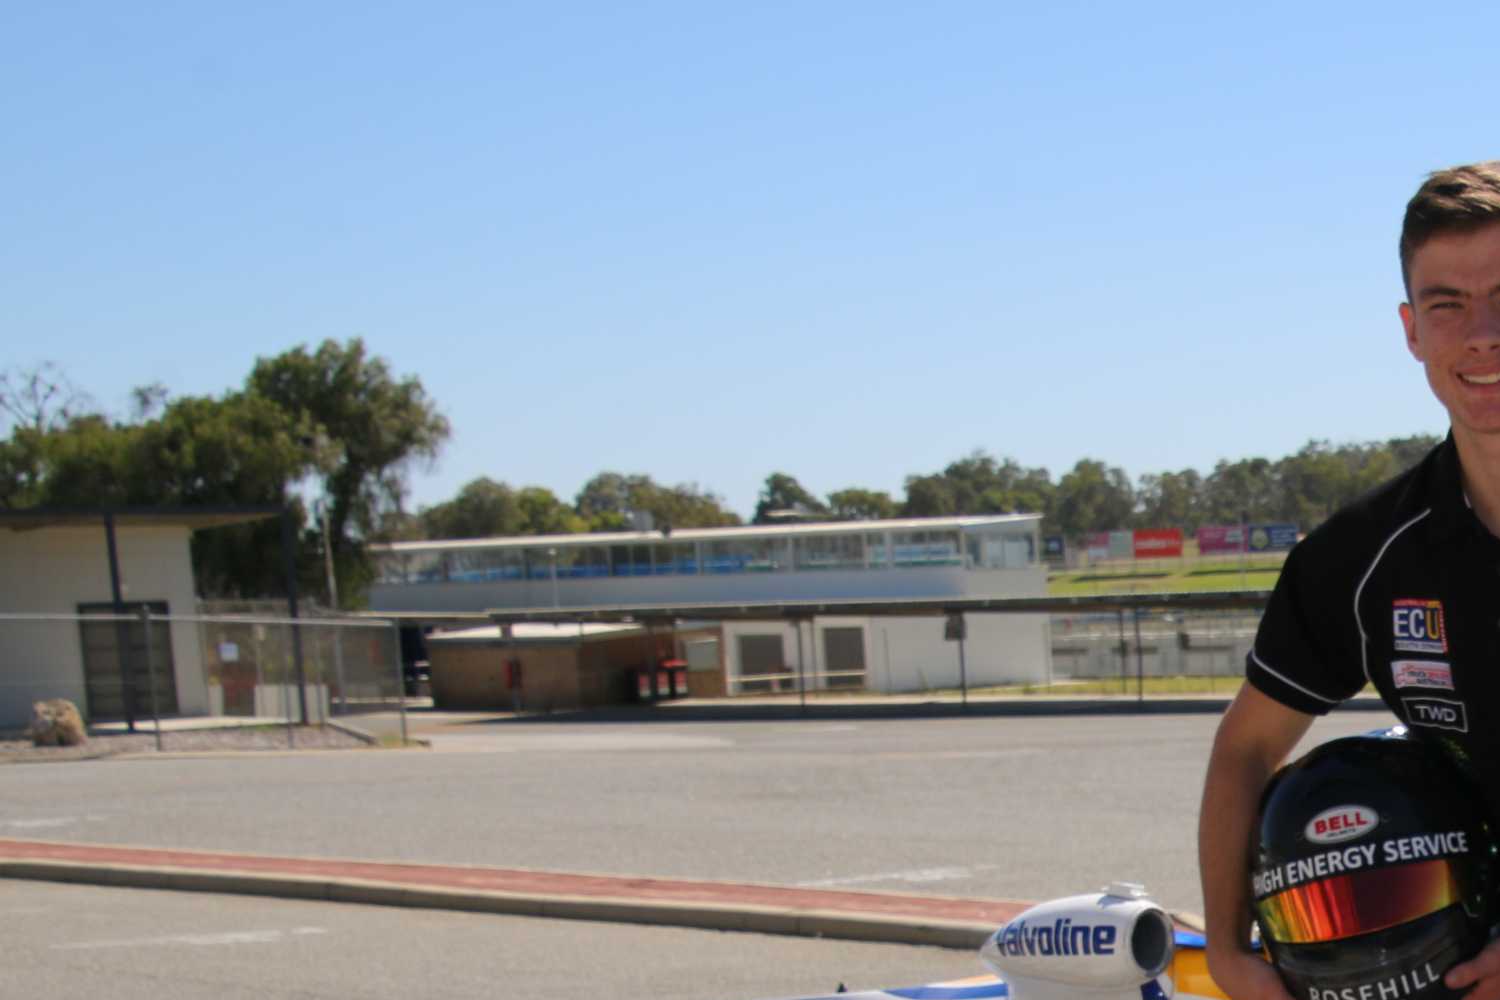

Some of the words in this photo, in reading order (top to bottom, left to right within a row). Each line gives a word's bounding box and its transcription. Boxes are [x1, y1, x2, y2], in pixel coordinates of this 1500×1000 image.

[1393, 608, 1440, 640] ECU
[1414, 705, 1457, 722] TWD
[1314, 811, 1368, 835] BELL
[1286, 843, 1377, 884] ENERGY
[1382, 831, 1469, 862] SERVICE
